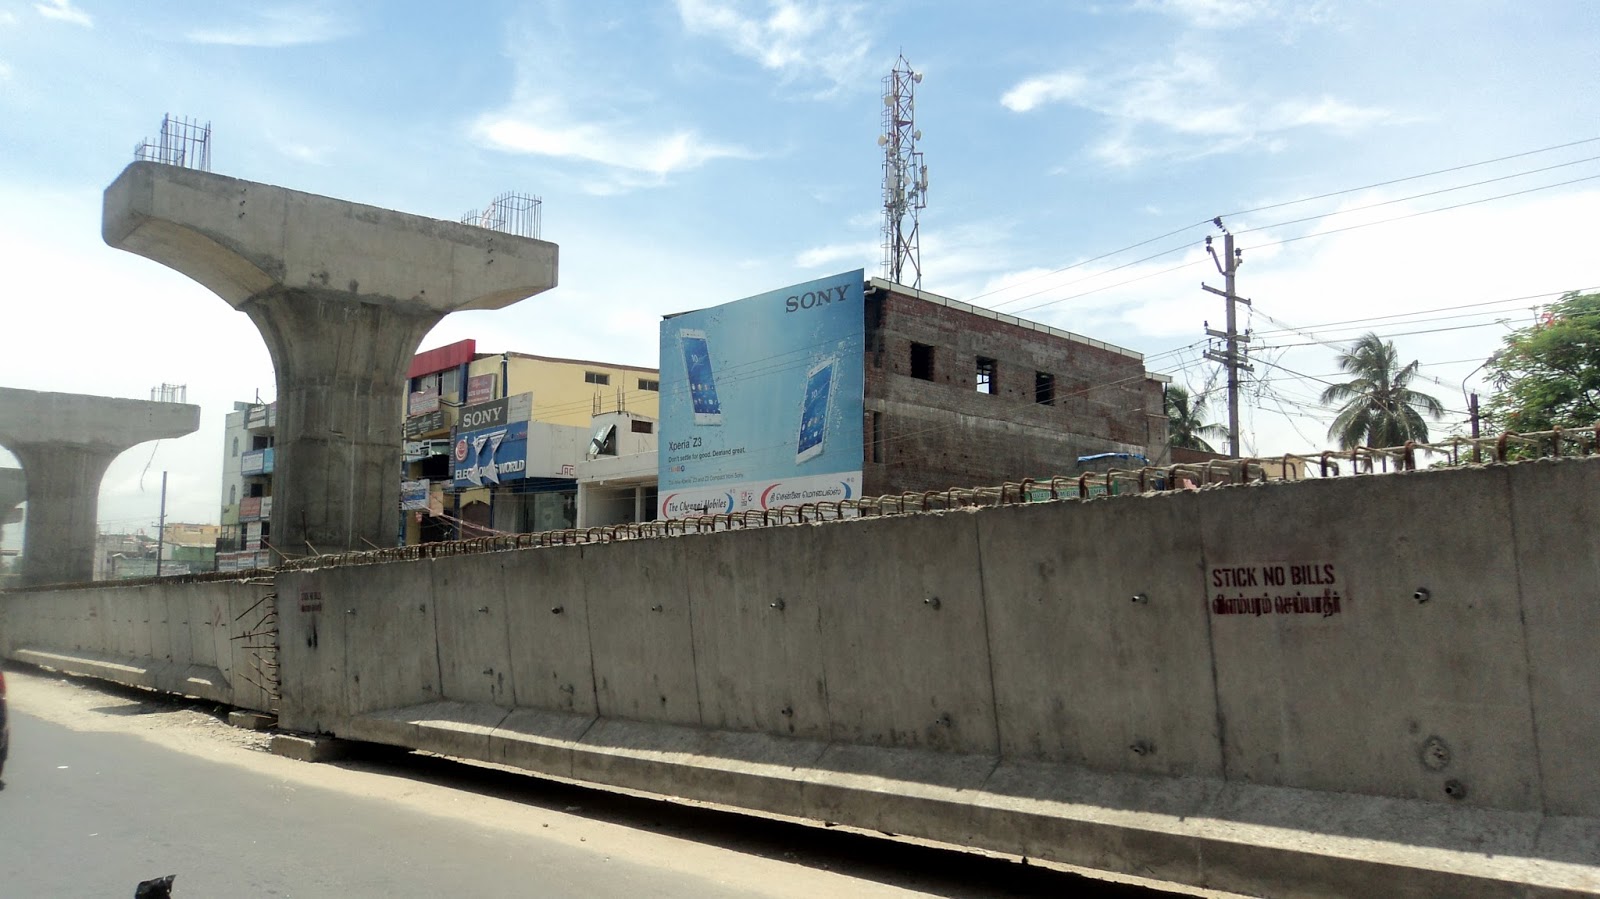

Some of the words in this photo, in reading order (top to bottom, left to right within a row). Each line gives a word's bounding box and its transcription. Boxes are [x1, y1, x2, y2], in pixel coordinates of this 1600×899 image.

[785, 284, 851, 313] SONY
[463, 406, 502, 428] SONY
[693, 437, 702, 448] Z3
[712, 448, 732, 457] Demand
[499, 460, 525, 474] WORLD
[669, 503, 678, 512] The
[1212, 567, 1258, 588] STICK
[1263, 566, 1286, 587] NO
[1290, 563, 1335, 586] BILLS
